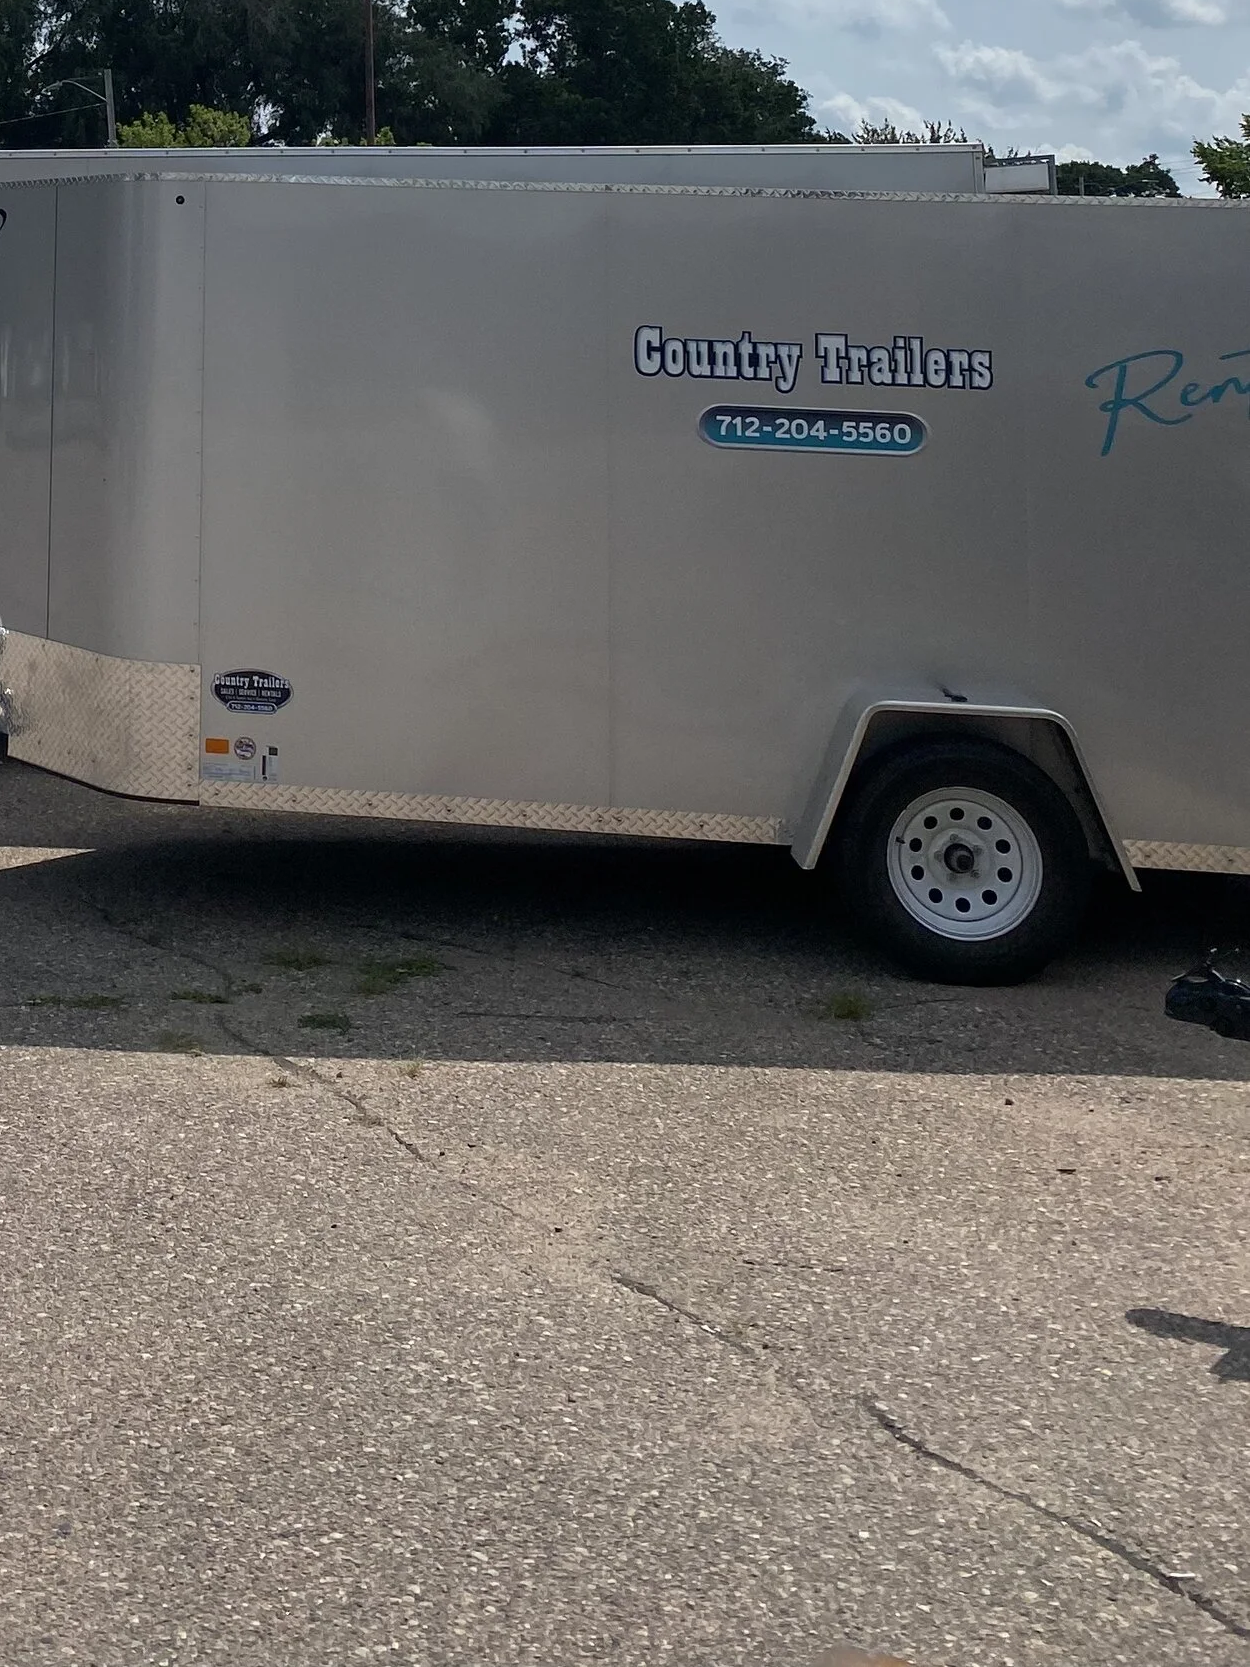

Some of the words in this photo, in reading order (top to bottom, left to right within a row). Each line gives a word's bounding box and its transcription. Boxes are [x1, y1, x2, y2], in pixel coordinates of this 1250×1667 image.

[634, 325, 803, 394] Country
[815, 333, 994, 390] Trailers
[716, 415, 912, 444] 712-204-5560
[214, 674, 250, 689] Country
[252, 675, 290, 689] Trailers
